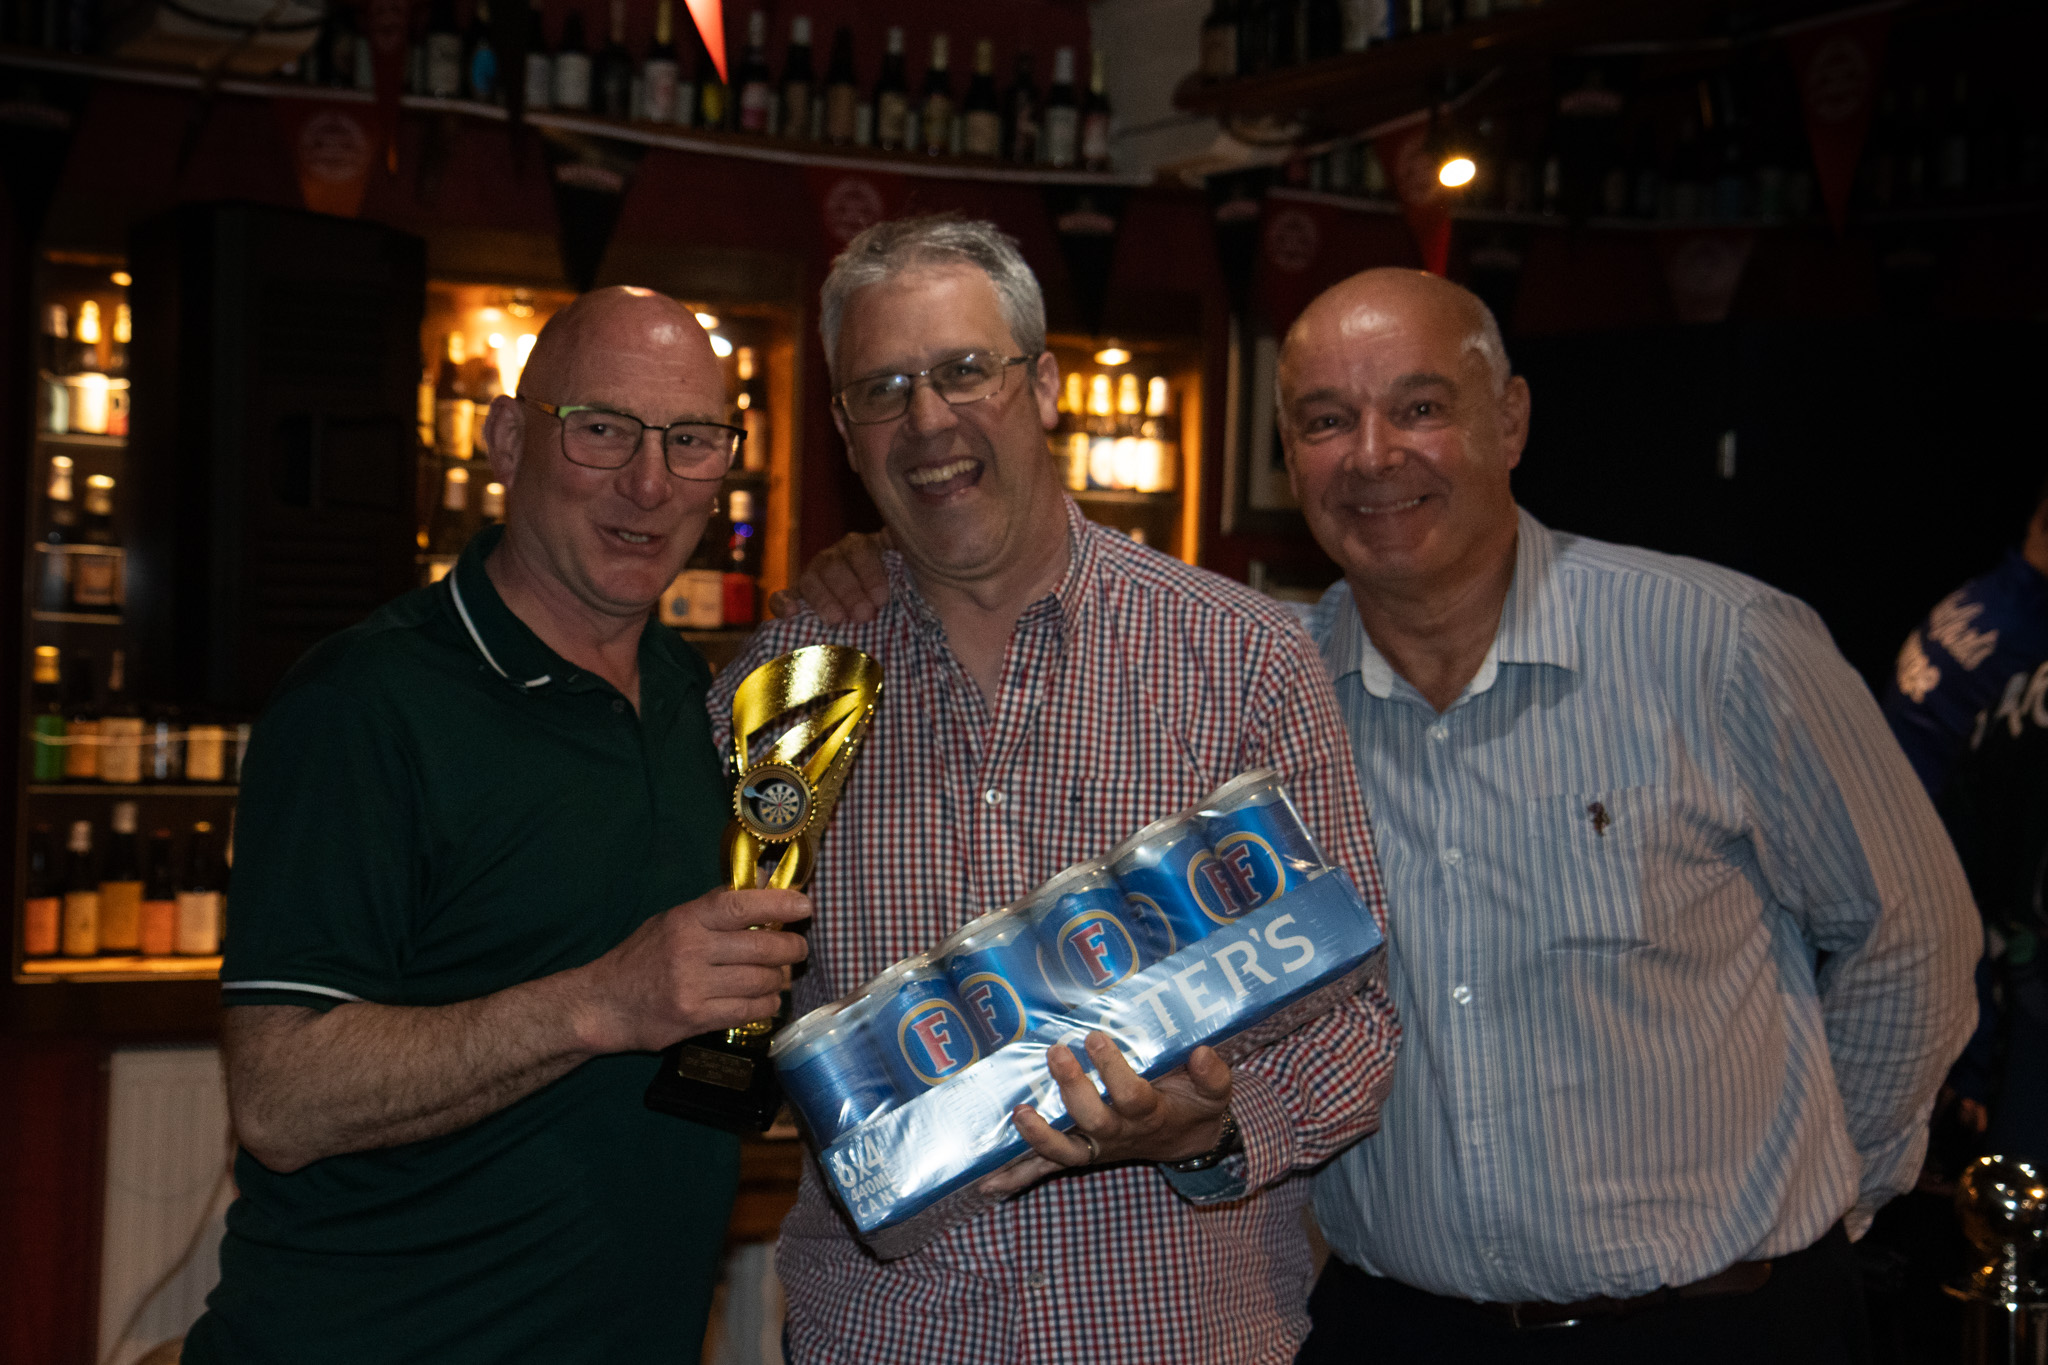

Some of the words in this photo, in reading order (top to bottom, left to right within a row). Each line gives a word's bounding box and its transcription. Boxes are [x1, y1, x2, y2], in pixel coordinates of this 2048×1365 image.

[1222, 843, 1262, 905] F
[1069, 922, 1112, 986] F
[912, 1011, 957, 1075] F
[966, 984, 1003, 1046] F
[851, 1170, 895, 1203] 440ML
[857, 1184, 903, 1217] CANS
